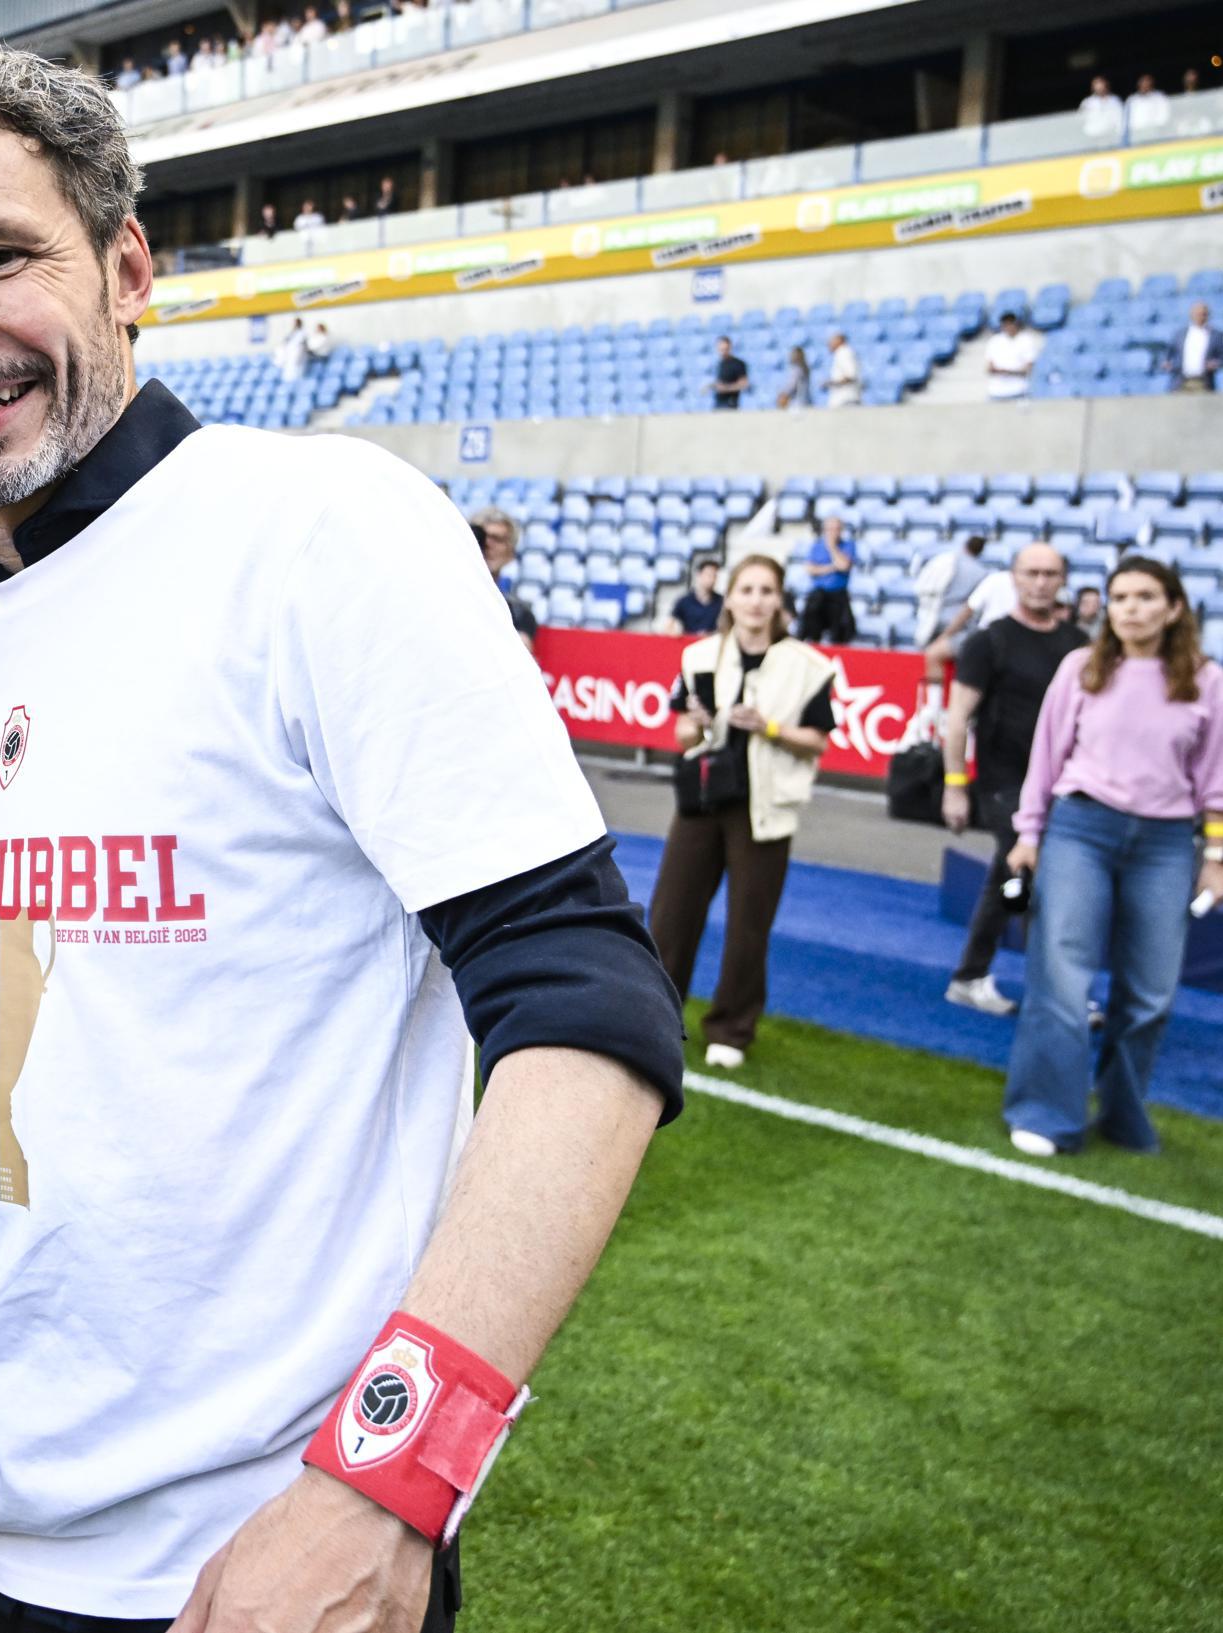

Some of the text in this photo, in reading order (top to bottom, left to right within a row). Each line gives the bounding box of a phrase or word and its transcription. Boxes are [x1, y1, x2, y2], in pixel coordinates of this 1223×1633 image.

[56, 927, 207, 945] BEKER VAN BELGIË 2023
[354, 1436, 365, 1454] 1
